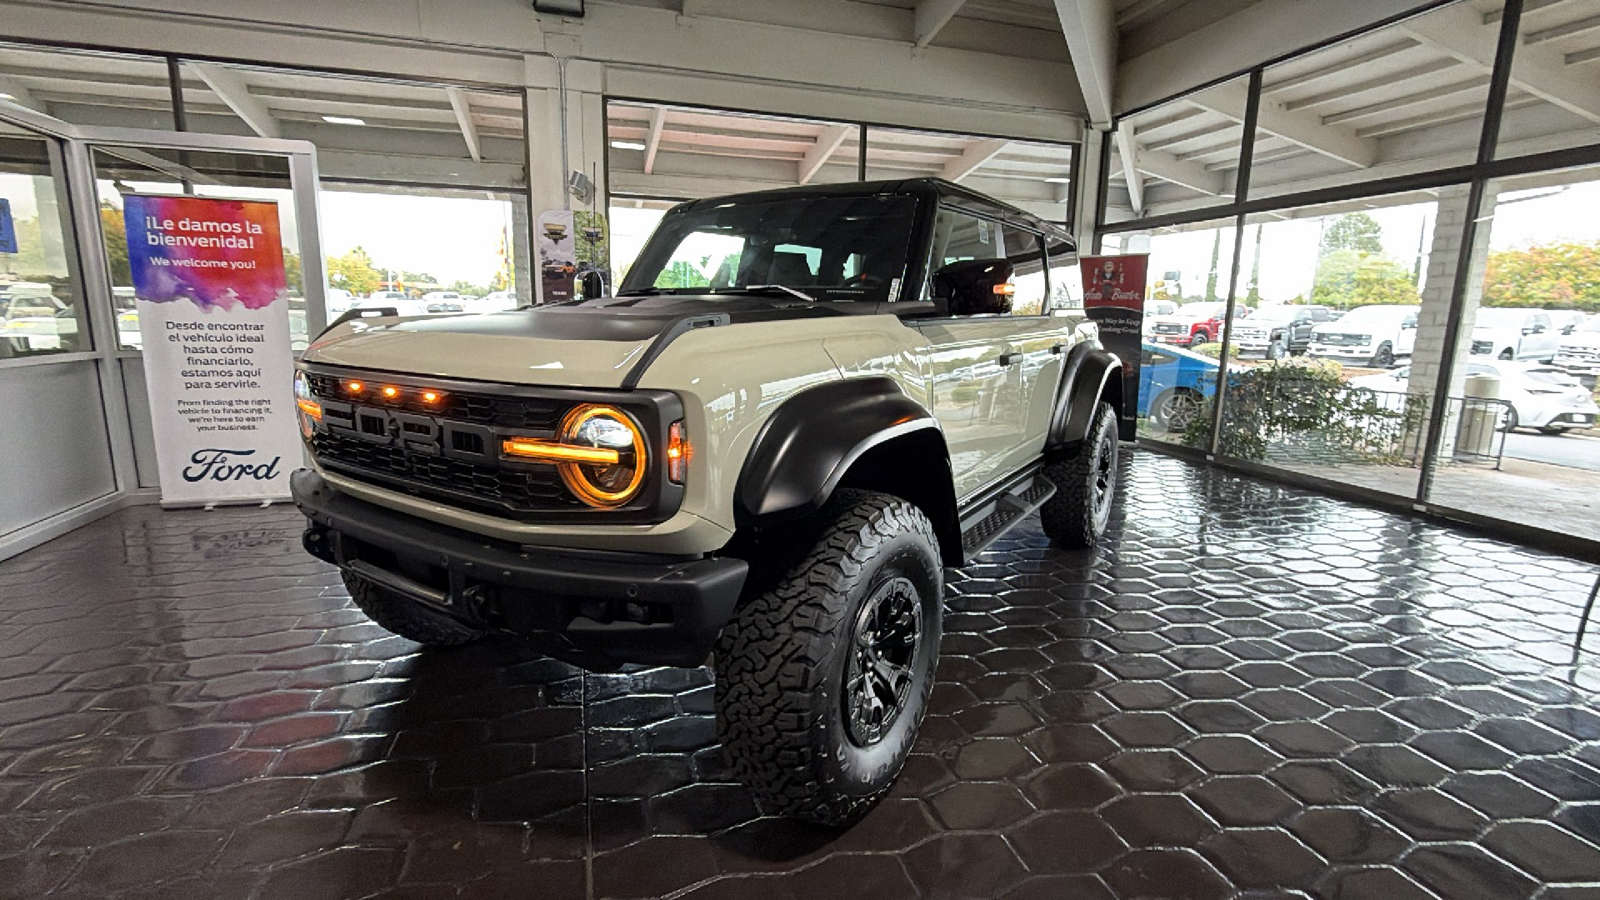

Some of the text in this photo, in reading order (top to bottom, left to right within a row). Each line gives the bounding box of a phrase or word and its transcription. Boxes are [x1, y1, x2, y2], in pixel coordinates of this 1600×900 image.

[178, 218, 242, 233] damos
[246, 220, 262, 234] la
[147, 232, 254, 249] bienvenida!
[149, 256, 256, 270] We welcome you!
[166, 321, 265, 331] Desde encontrar
[168, 333, 265, 343] el vehículo ideal
[183, 345, 254, 354] hasta cómo
[181, 367, 262, 379] estamos aquí
[184, 379, 261, 390] para servirle.
[202, 399, 234, 407] finding
[251, 399, 272, 407] right
[222, 407, 263, 415] financing
[196, 425, 217, 433] your
[321, 399, 496, 462] FORD
[182, 448, 281, 482] Ford
